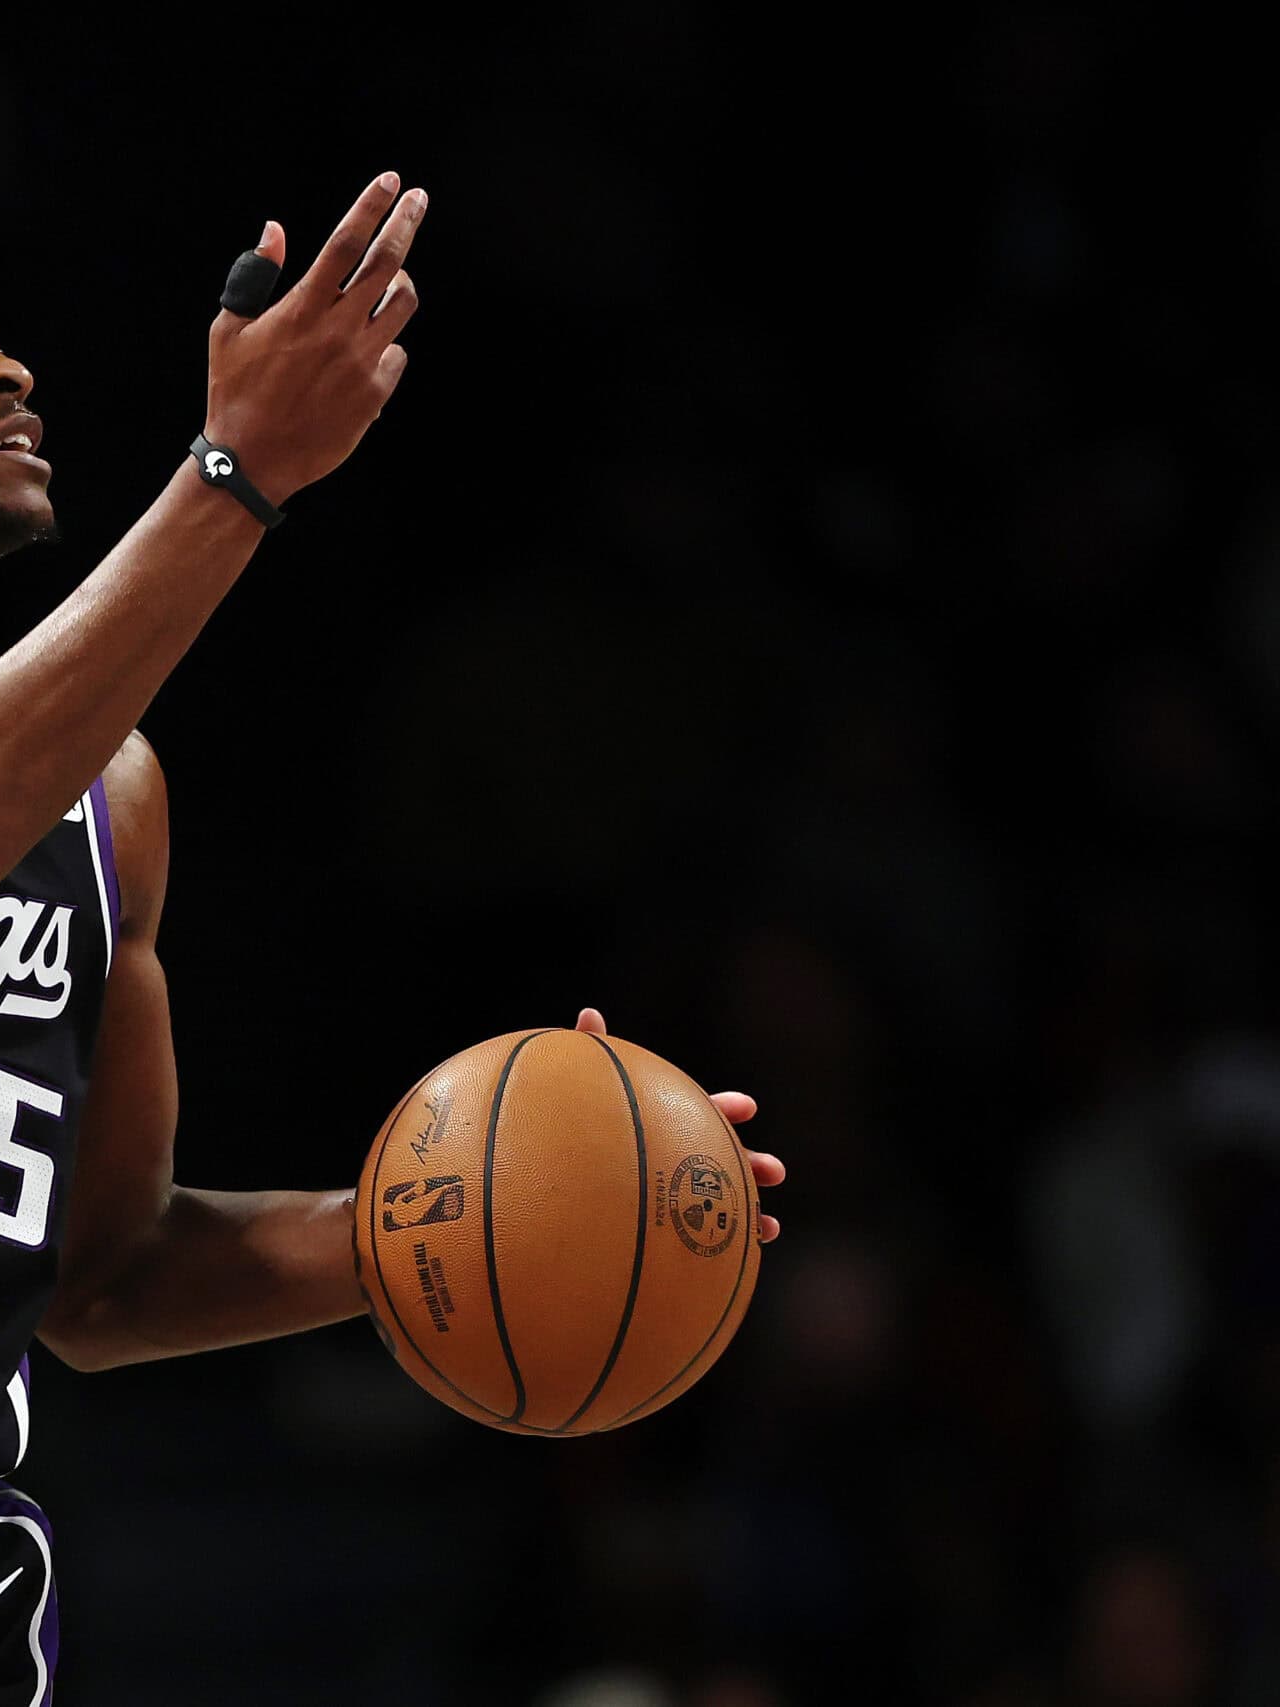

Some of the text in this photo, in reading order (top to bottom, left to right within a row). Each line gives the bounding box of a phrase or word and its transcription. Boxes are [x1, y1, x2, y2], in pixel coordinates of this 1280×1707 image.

[414, 1242, 428, 1266] BALL
[417, 1267, 435, 1293] GAME
[425, 1293, 449, 1333] OFFICIAL
